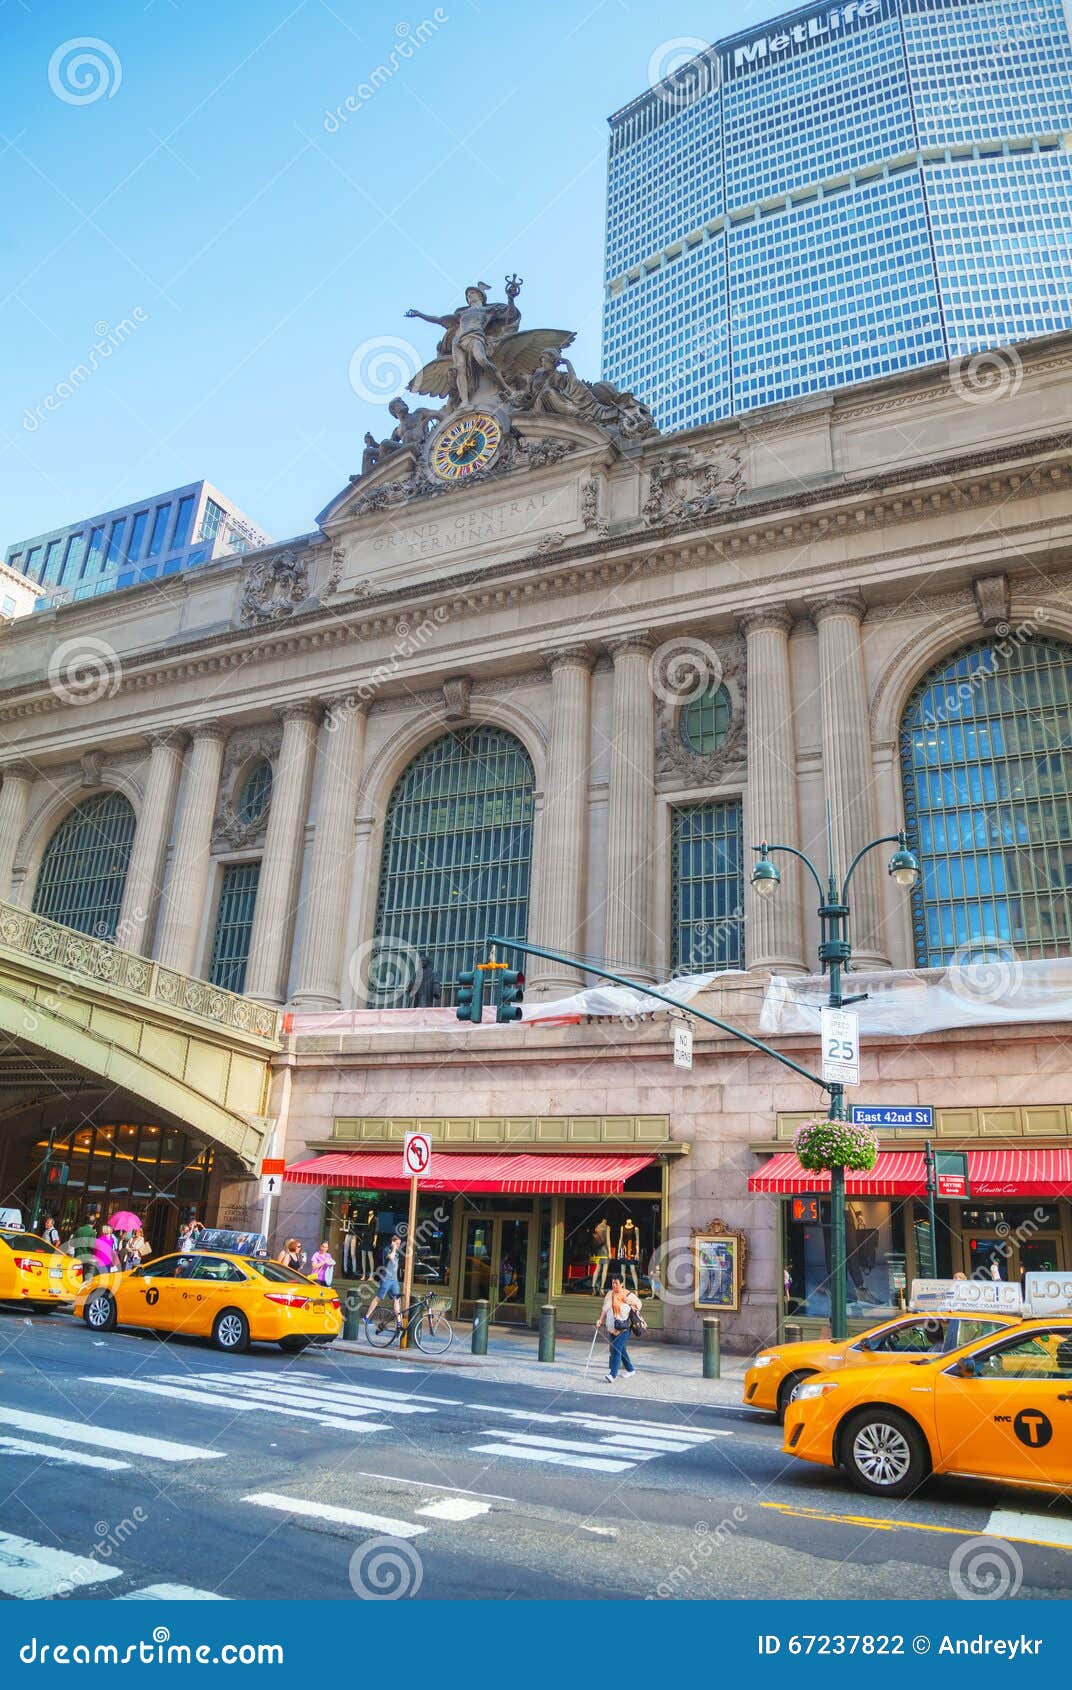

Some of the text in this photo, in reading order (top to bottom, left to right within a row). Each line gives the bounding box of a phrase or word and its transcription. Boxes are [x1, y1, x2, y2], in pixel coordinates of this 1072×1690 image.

[734, 0, 880, 67] MetLife
[373, 495, 550, 551] GRAND CENTRAL
[408, 521, 506, 555] TERMINAL
[679, 1035, 688, 1046] NO
[828, 1039, 853, 1060] 25
[856, 1111, 929, 1123] East 42nd St
[1021, 1415, 1043, 1444] T
